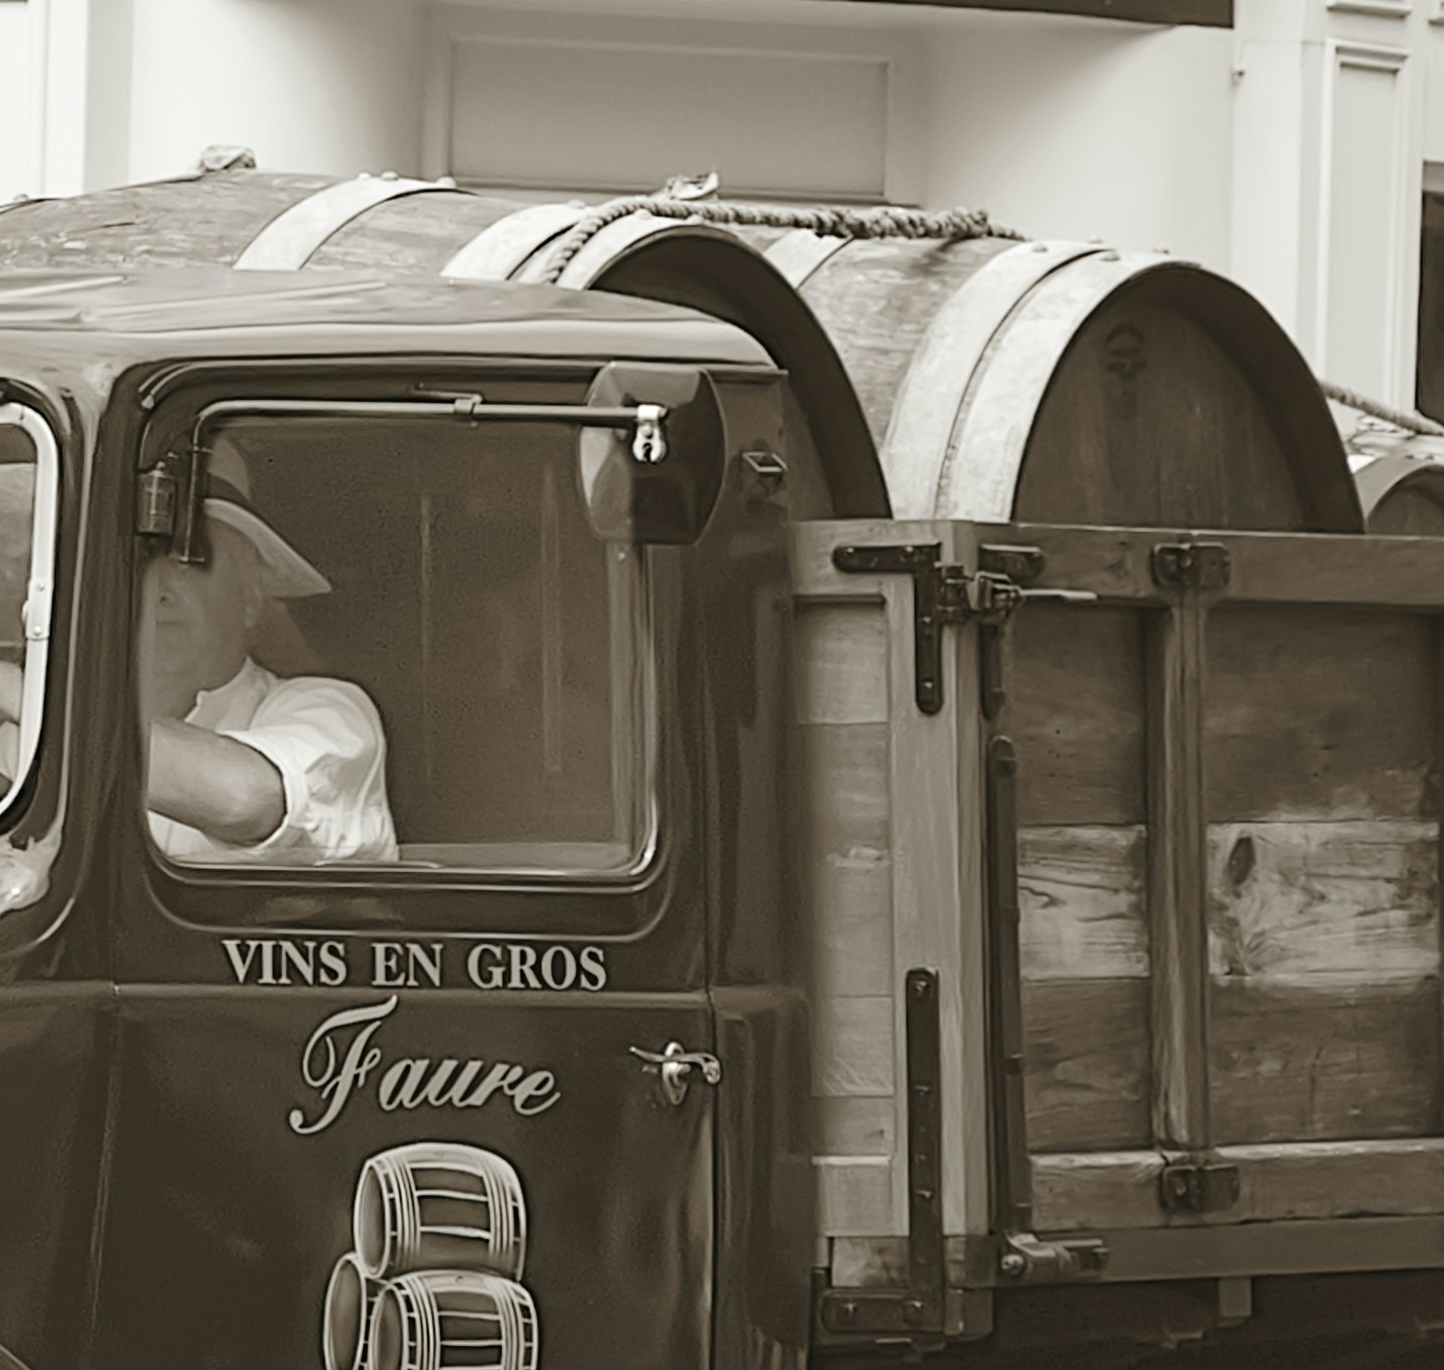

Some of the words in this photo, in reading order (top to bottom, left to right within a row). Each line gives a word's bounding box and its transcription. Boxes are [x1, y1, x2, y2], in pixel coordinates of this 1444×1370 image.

[221, 939, 348, 987] VINS
[370, 942, 443, 988] EN
[467, 943, 607, 991] GROS
[288, 994, 562, 1135] Faure
